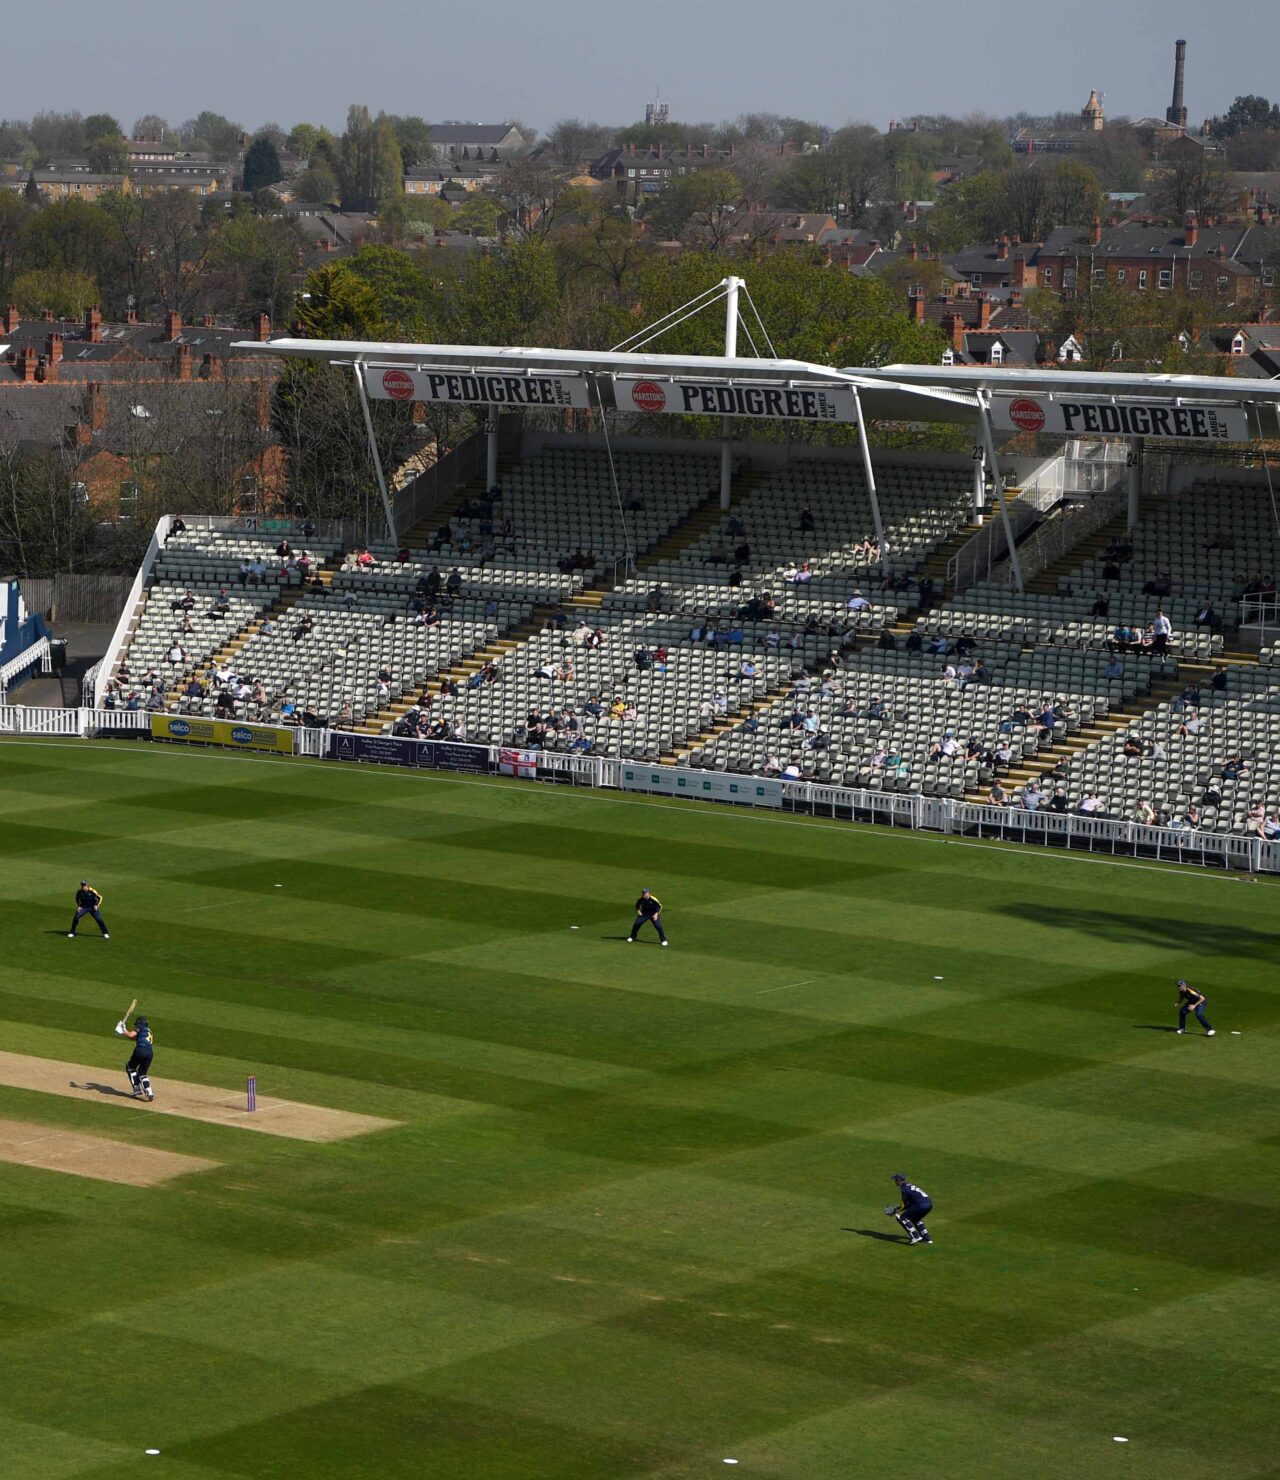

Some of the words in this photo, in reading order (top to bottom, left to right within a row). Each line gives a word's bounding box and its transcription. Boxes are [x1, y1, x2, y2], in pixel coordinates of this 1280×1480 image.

[427, 374, 556, 404] PEDIGREE
[555, 379, 565, 405] AMBER
[563, 390, 572, 405] ALE
[680, 385, 819, 418] PEDIGREE
[819, 391, 828, 419] AMBER
[829, 403, 837, 419] ALE
[485, 420, 495, 433] 22
[1060, 403, 1208, 438] PEDIGREE
[1208, 410, 1219, 438] AMBER
[1219, 422, 1229, 438] ALE
[972, 445, 983, 460] 23
[1127, 452, 1138, 468] 24
[169, 723, 189, 733] selco
[232, 730, 252, 740] selco
